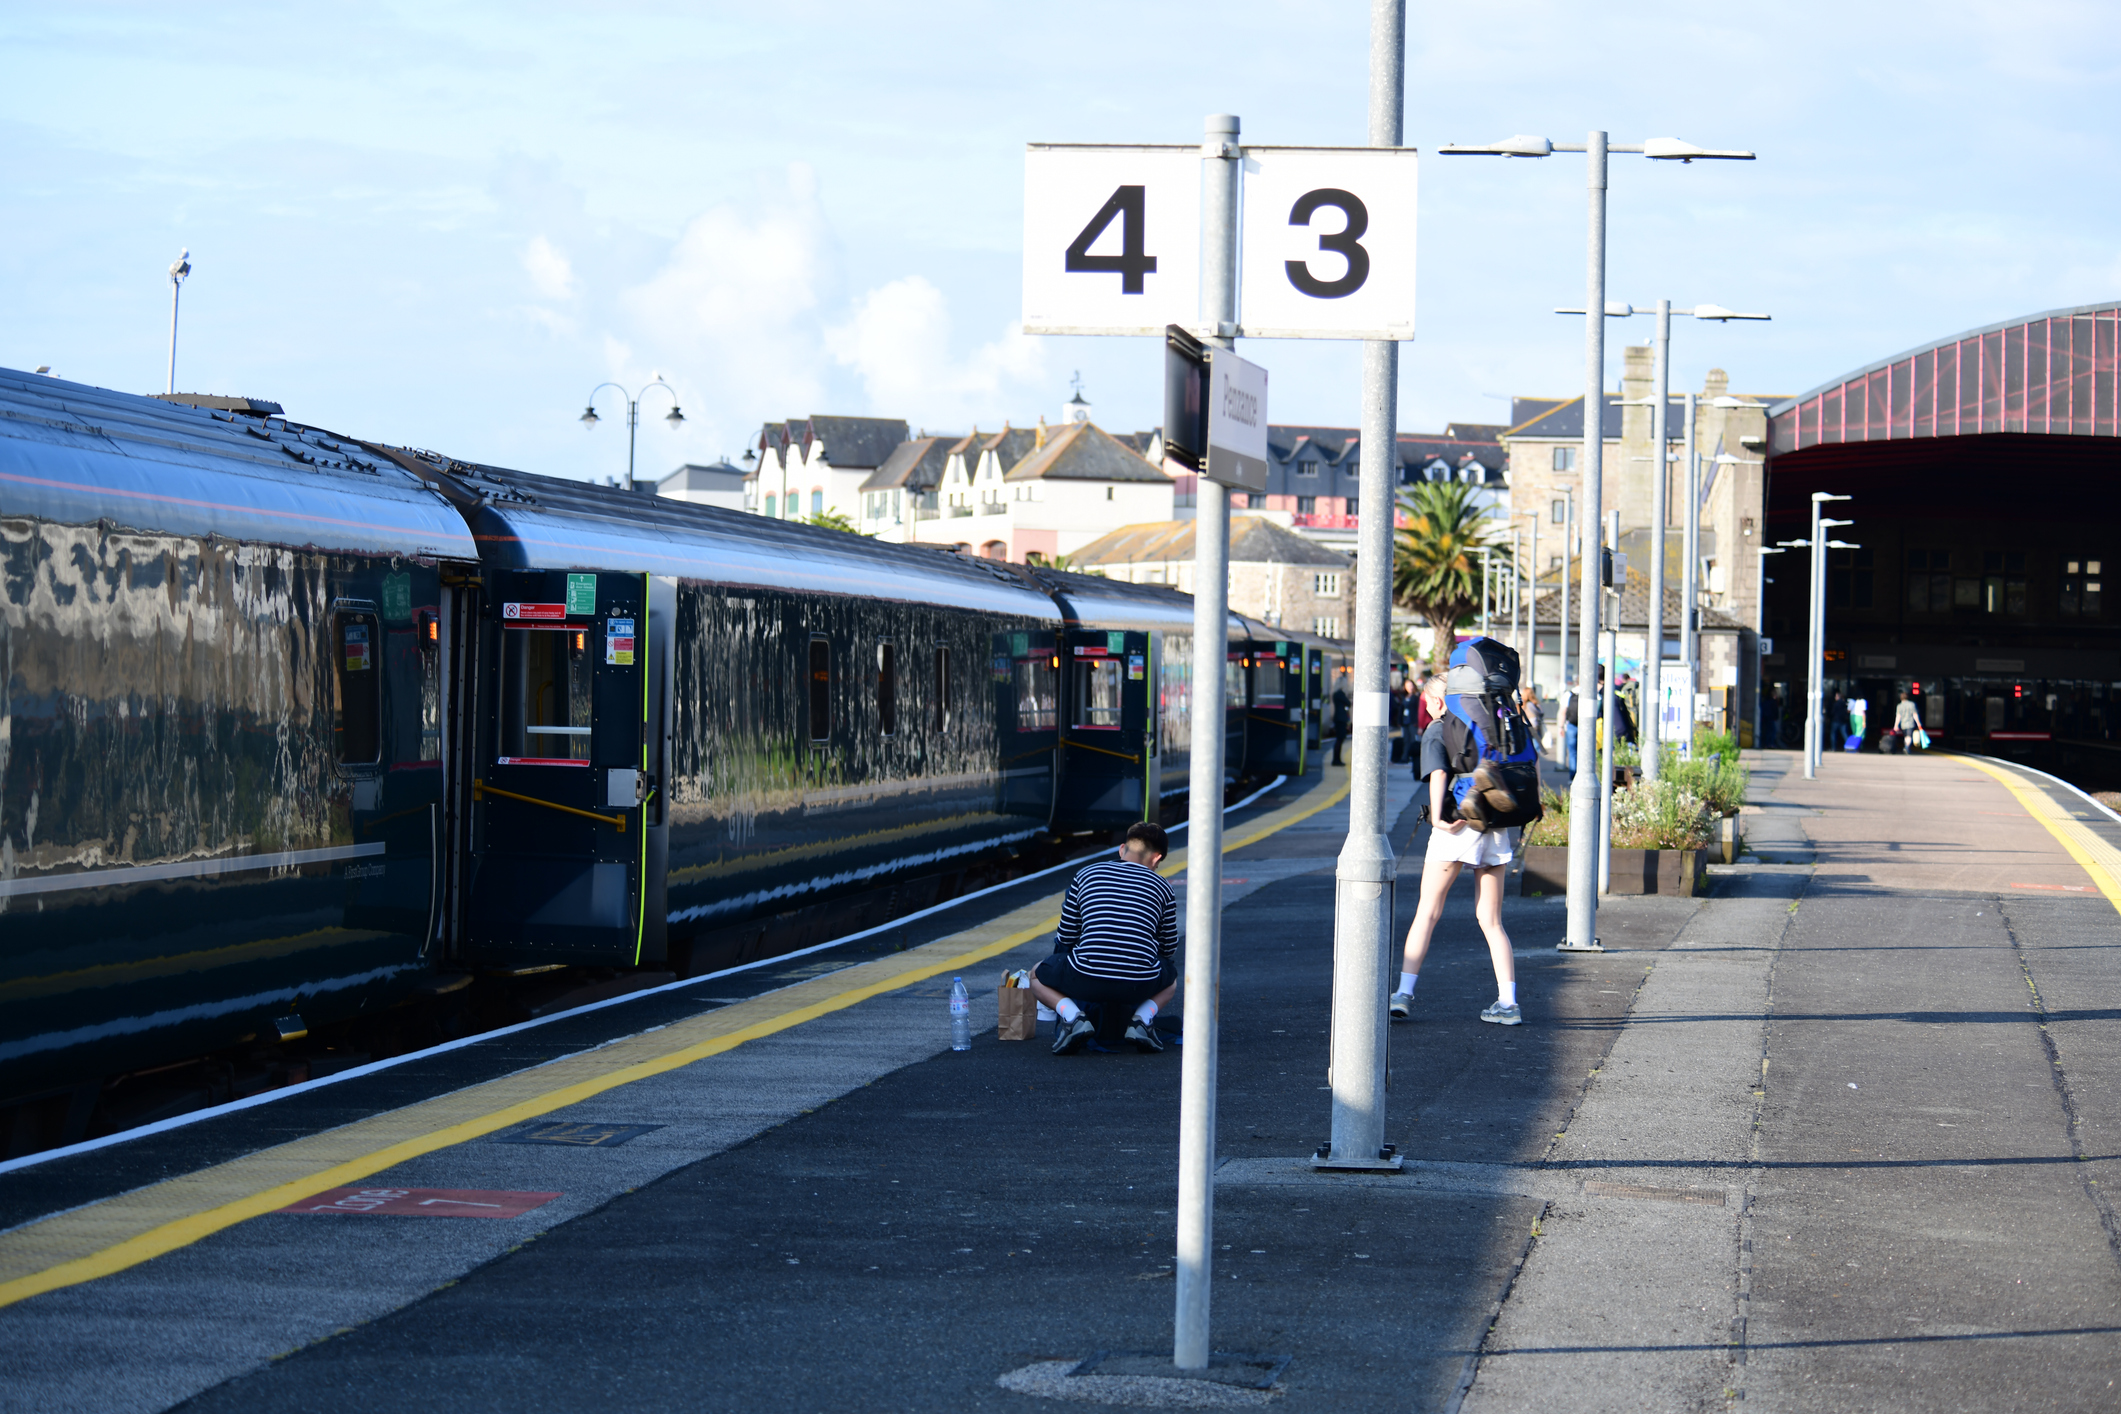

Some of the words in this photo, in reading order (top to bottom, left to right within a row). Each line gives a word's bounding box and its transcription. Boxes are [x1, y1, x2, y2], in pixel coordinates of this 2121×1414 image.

[1065, 185, 1157, 295] 4
[1284, 187, 1371, 300] 3
[1223, 373, 1258, 428] Penzance
